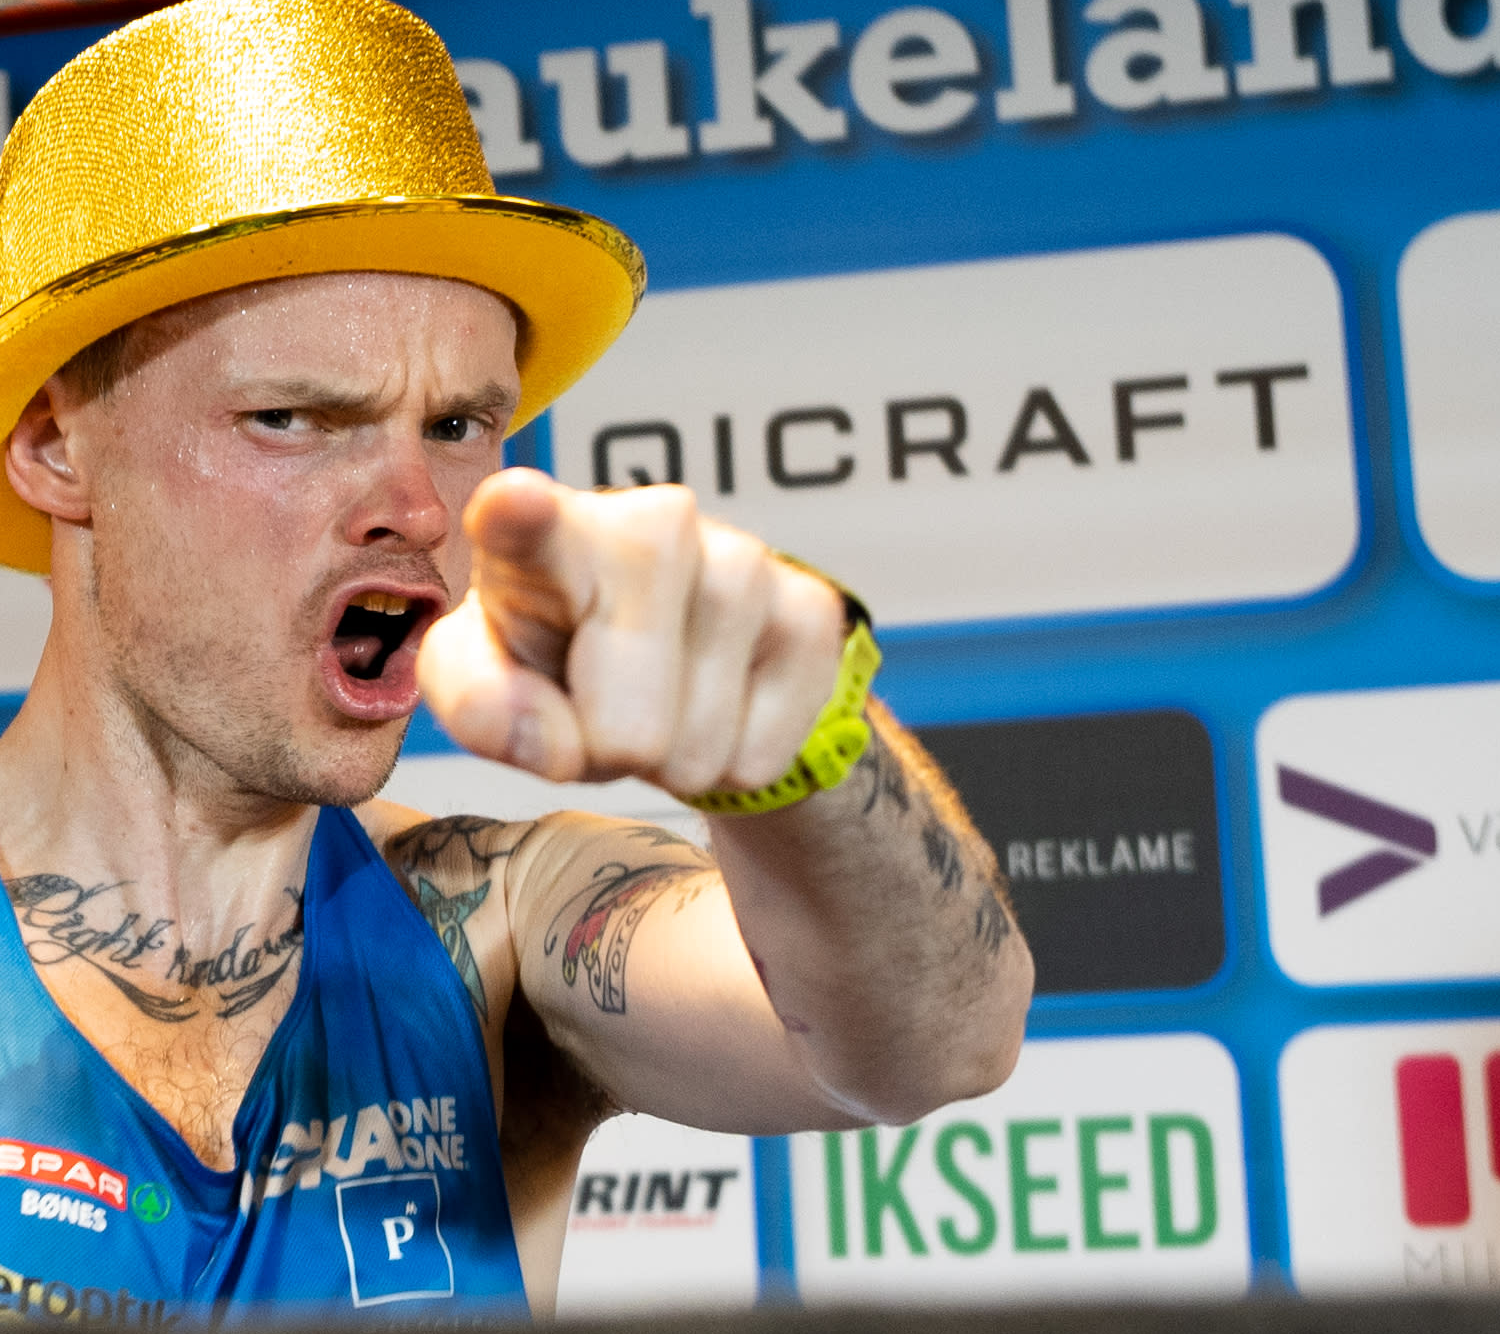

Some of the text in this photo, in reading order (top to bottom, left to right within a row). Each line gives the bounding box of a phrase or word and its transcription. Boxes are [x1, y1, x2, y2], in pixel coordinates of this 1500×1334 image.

[590, 364, 1310, 495] QICRAFT
[1007, 831, 1198, 880] REKLAME
[387, 1096, 457, 1135] ONE
[400, 1135, 466, 1171] ONE
[20, 1188, 108, 1233] BØNES
[575, 1168, 740, 1215] RINT
